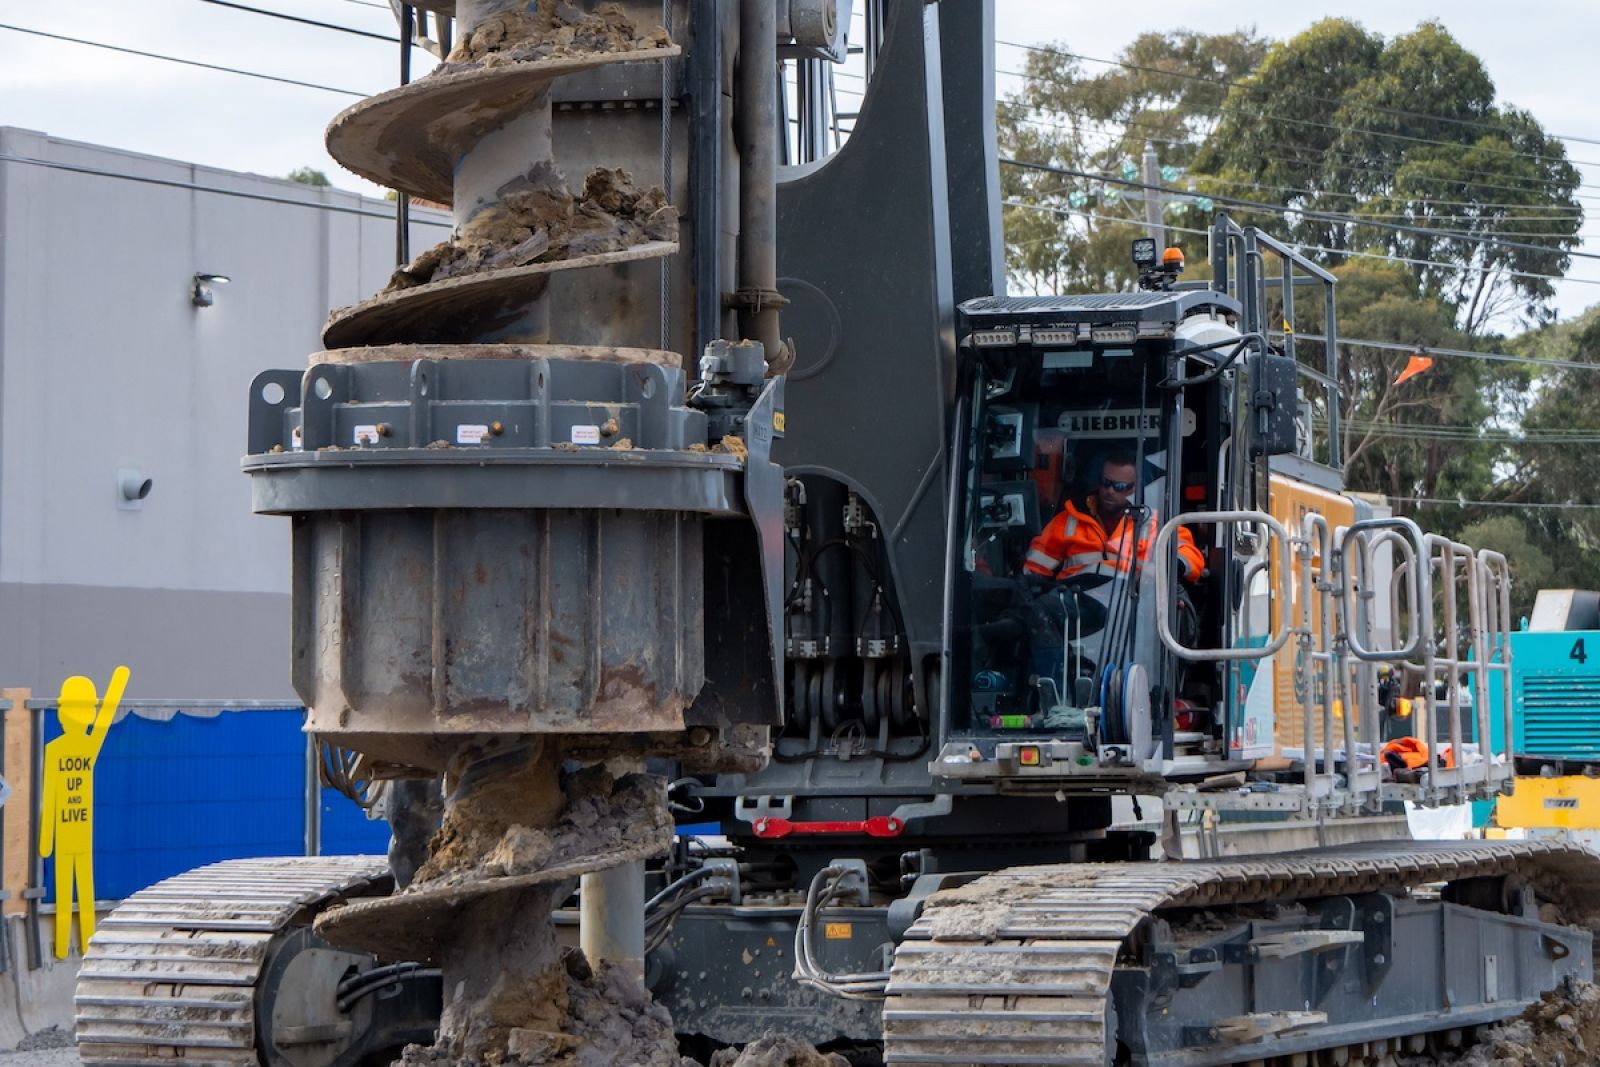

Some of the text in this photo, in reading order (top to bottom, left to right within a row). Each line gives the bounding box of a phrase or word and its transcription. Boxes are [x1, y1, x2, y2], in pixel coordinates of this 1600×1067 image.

[1071, 415, 1161, 431] LIEBHER
[1569, 638, 1588, 664] 4
[59, 757, 91, 771] LOOK
[67, 777, 82, 791] UP
[67, 796, 82, 804] AND
[62, 808, 87, 823] LIVE
